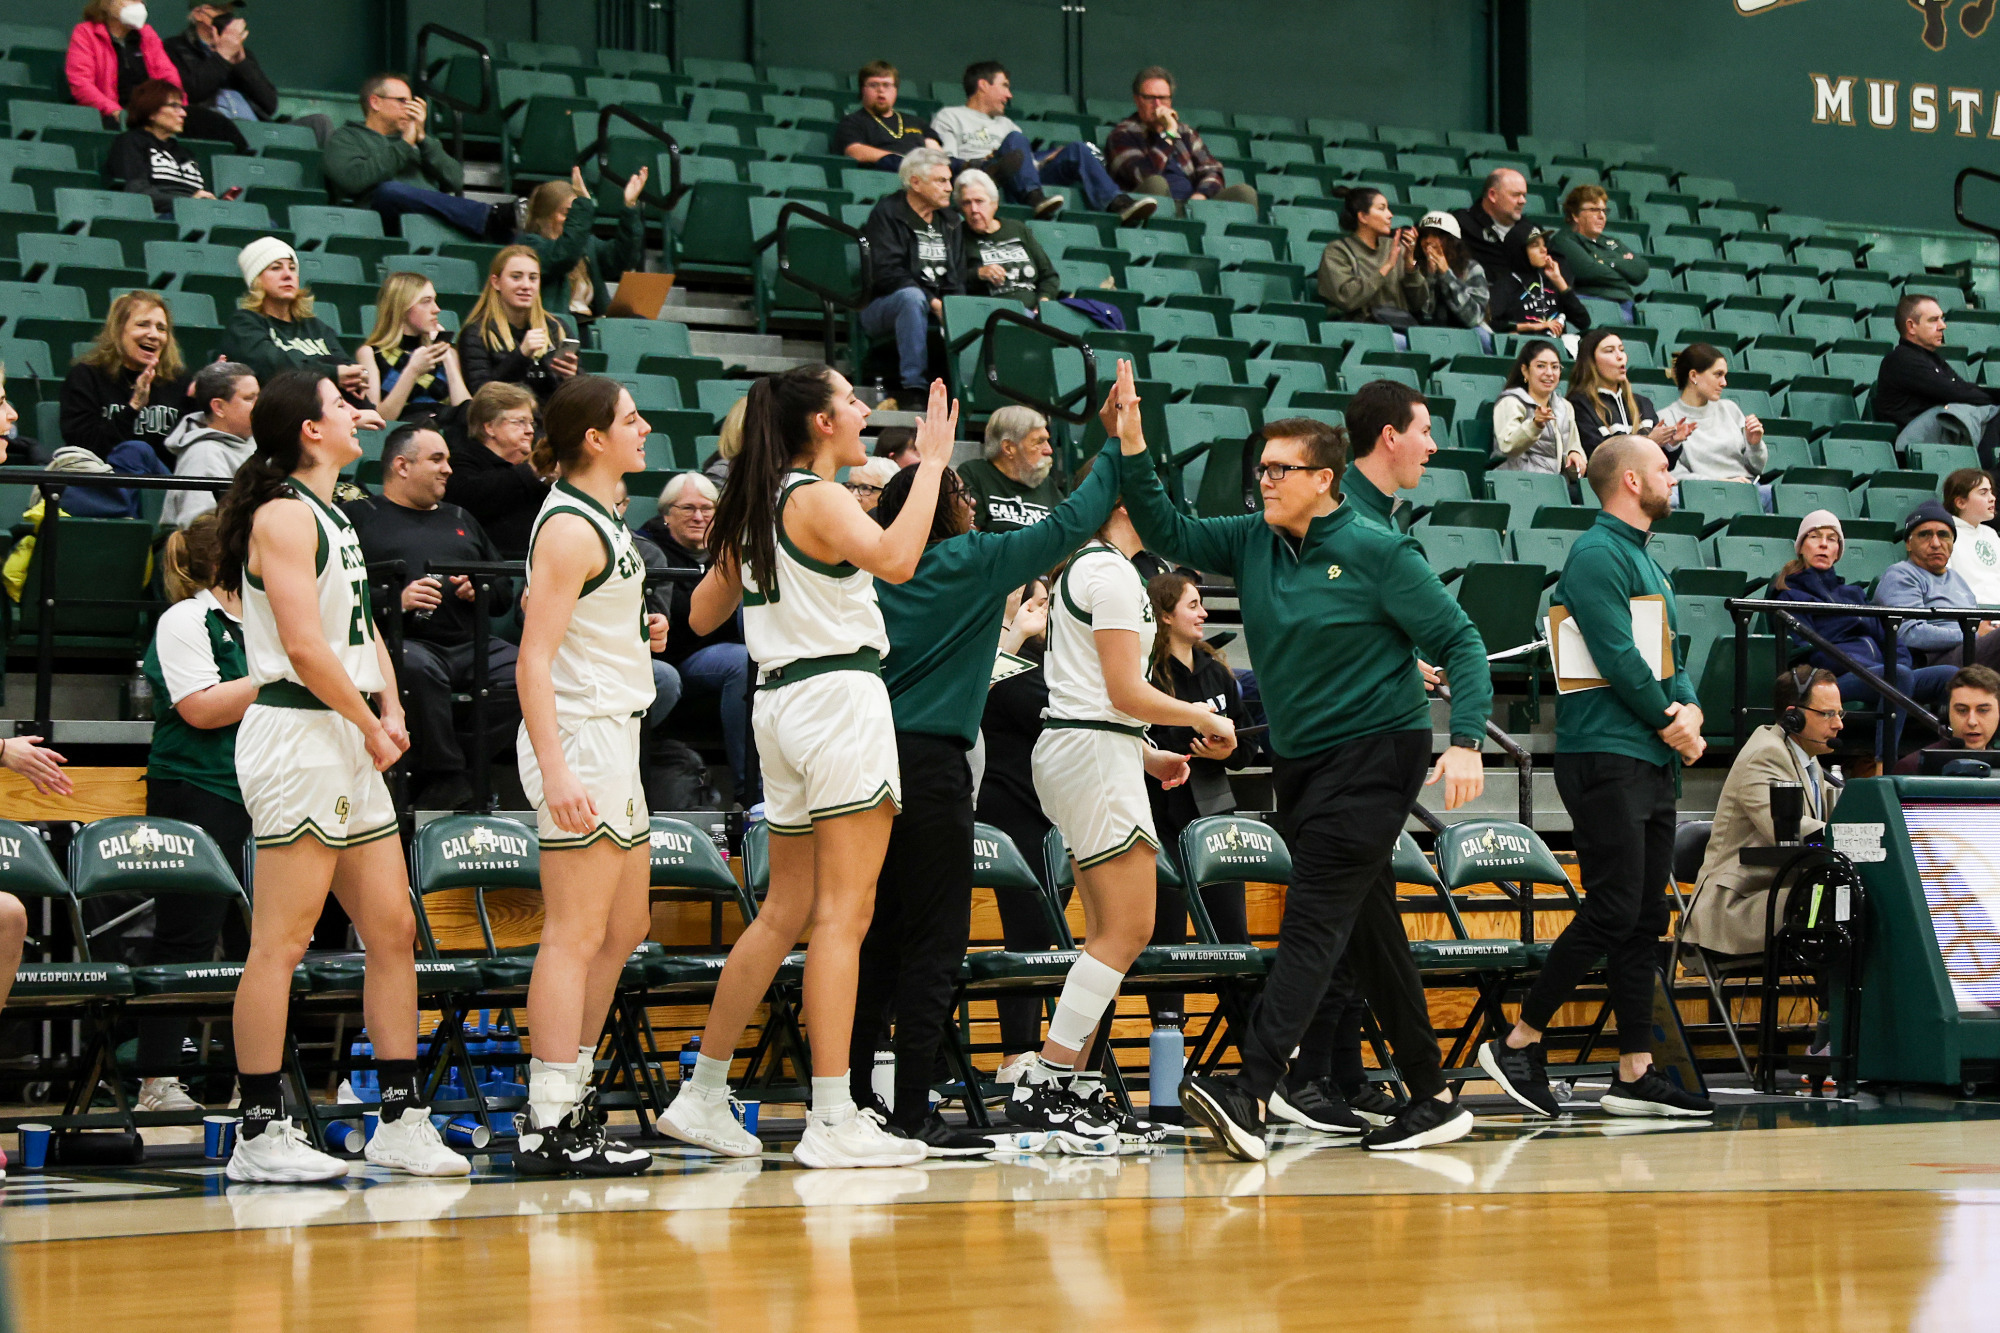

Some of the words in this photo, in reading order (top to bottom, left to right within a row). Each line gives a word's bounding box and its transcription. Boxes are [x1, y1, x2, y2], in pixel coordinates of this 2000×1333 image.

[98, 835, 132, 860] CAL
[152, 832, 195, 857] POLY
[441, 836, 471, 860] CAL
[490, 835, 528, 857] POLY
[1205, 832, 1229, 854] CAL
[1240, 831, 1273, 853] POLY
[1461, 837, 1485, 858] CAL
[1498, 834, 1531, 854] POLY
[974, 838, 999, 859] OLY
[117, 859, 185, 870] MUSTANGS
[458, 860, 520, 870] MUSTANGS
[650, 856, 685, 866] TANGS
[1220, 855, 1267, 864] MUSTANGS
[1476, 856, 1525, 867] MUSTANGS
[1438, 945, 1509, 955] WWW.GOPOLY.COM
[1171, 952, 1246, 960] WWW.GOPOLY.COM
[15, 971, 107, 982] WW.GOPOLY.COM
